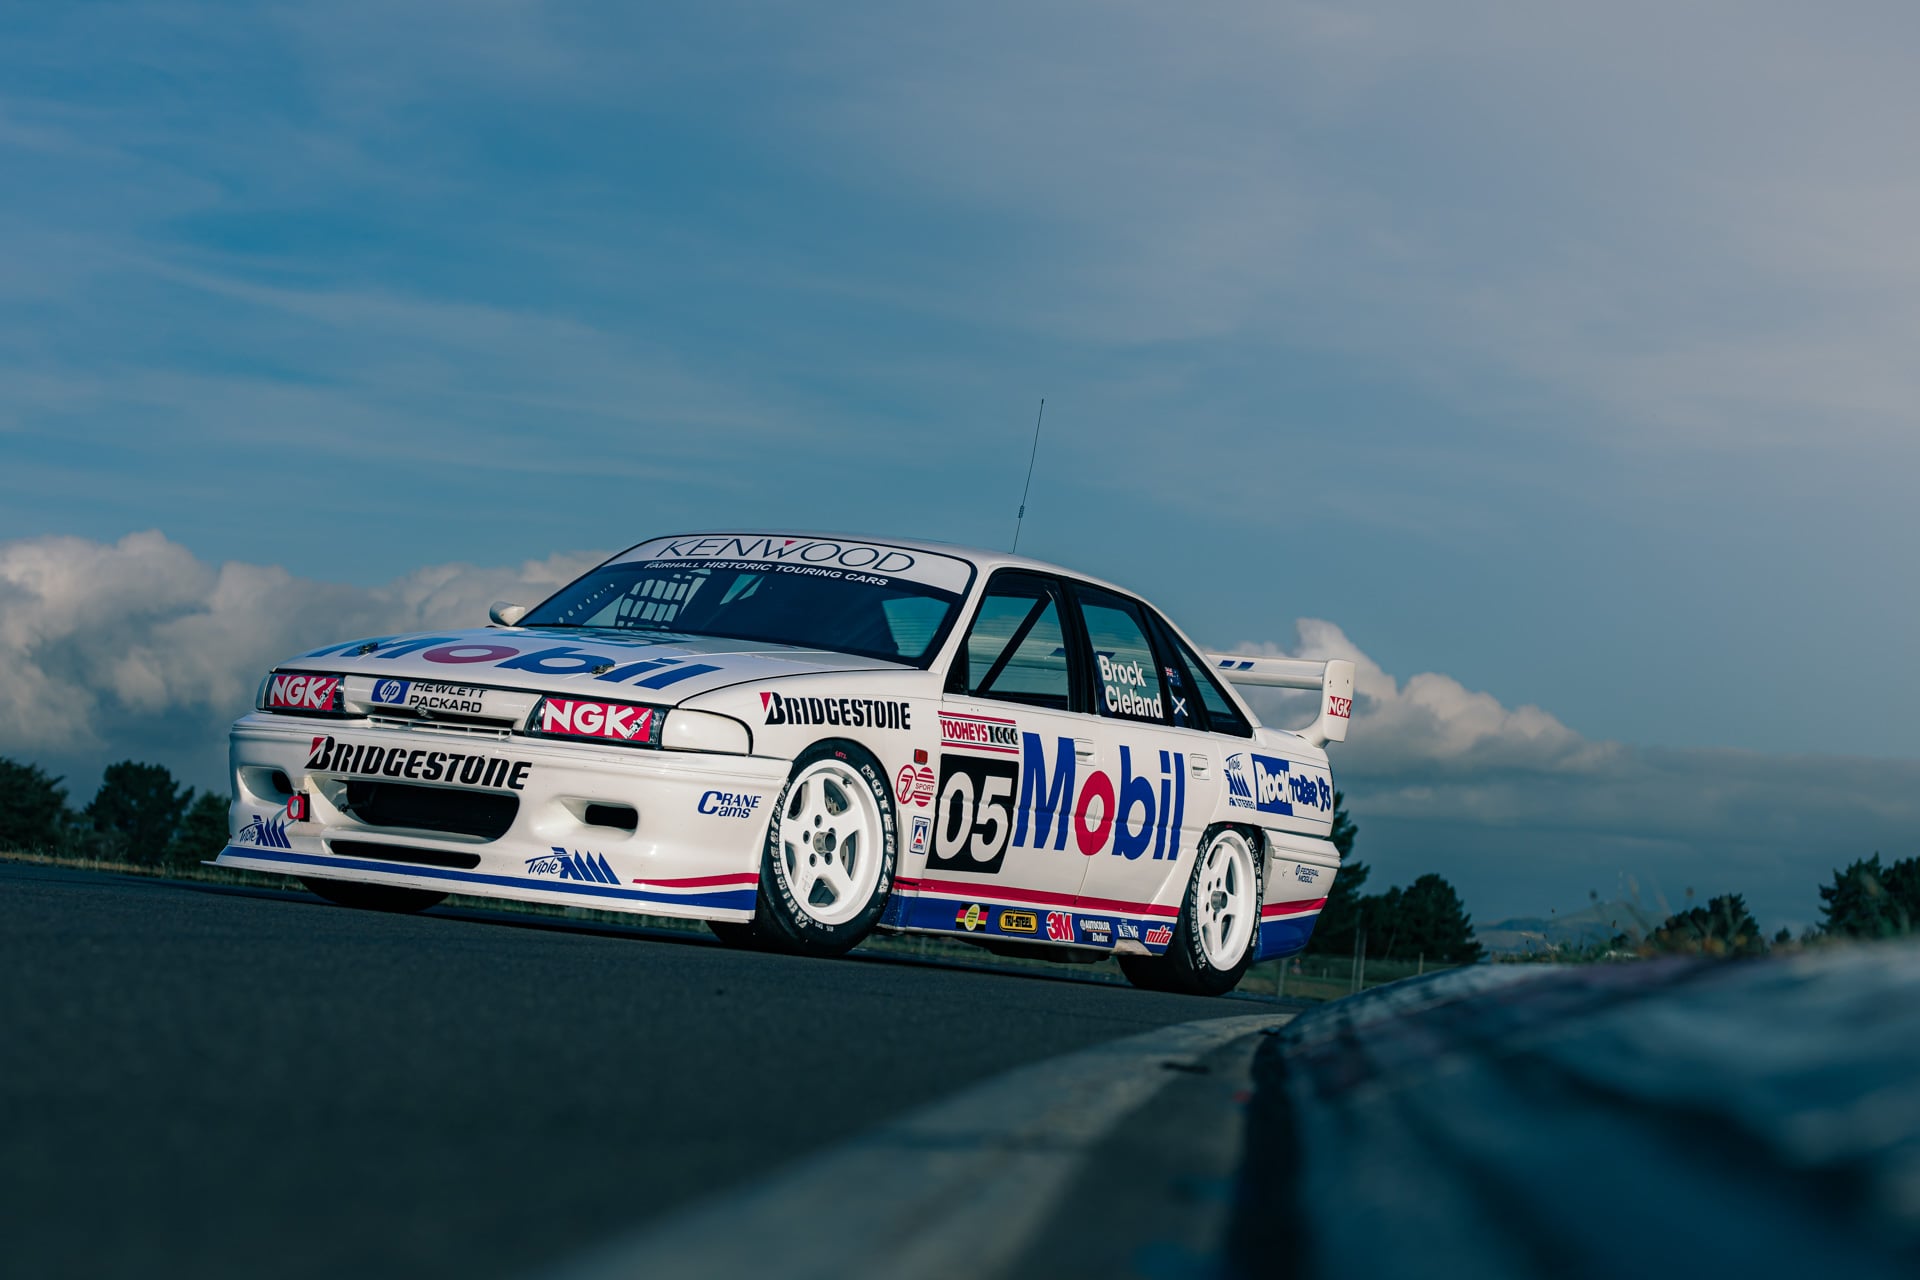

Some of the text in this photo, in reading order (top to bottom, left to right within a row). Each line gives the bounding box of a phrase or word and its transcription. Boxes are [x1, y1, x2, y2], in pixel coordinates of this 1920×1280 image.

[656, 538, 915, 573] KENWOOD
[644, 561, 889, 586] FAIRHALL HISTORIC TOURING CARS
[306, 636, 725, 690] Mobil
[1099, 654, 1147, 688] Brock
[269, 675, 322, 709] NGK
[381, 680, 400, 703] hp
[408, 695, 483, 714] PACKARD
[412, 681, 488, 699] HEWLETT
[1104, 685, 1164, 719] Cleland
[1328, 696, 1351, 718] NGK
[543, 699, 640, 740] NGK
[760, 691, 912, 730] BRIDGESTONE
[940, 719, 988, 743] TOOHEYS
[304, 735, 533, 791] BRIDGESTONE
[915, 782, 935, 792] SPORT
[1012, 730, 1186, 862] Mobil
[935, 771, 1013, 863] 05
[524, 853, 573, 876] Triple
[1047, 911, 1075, 942] 3M
